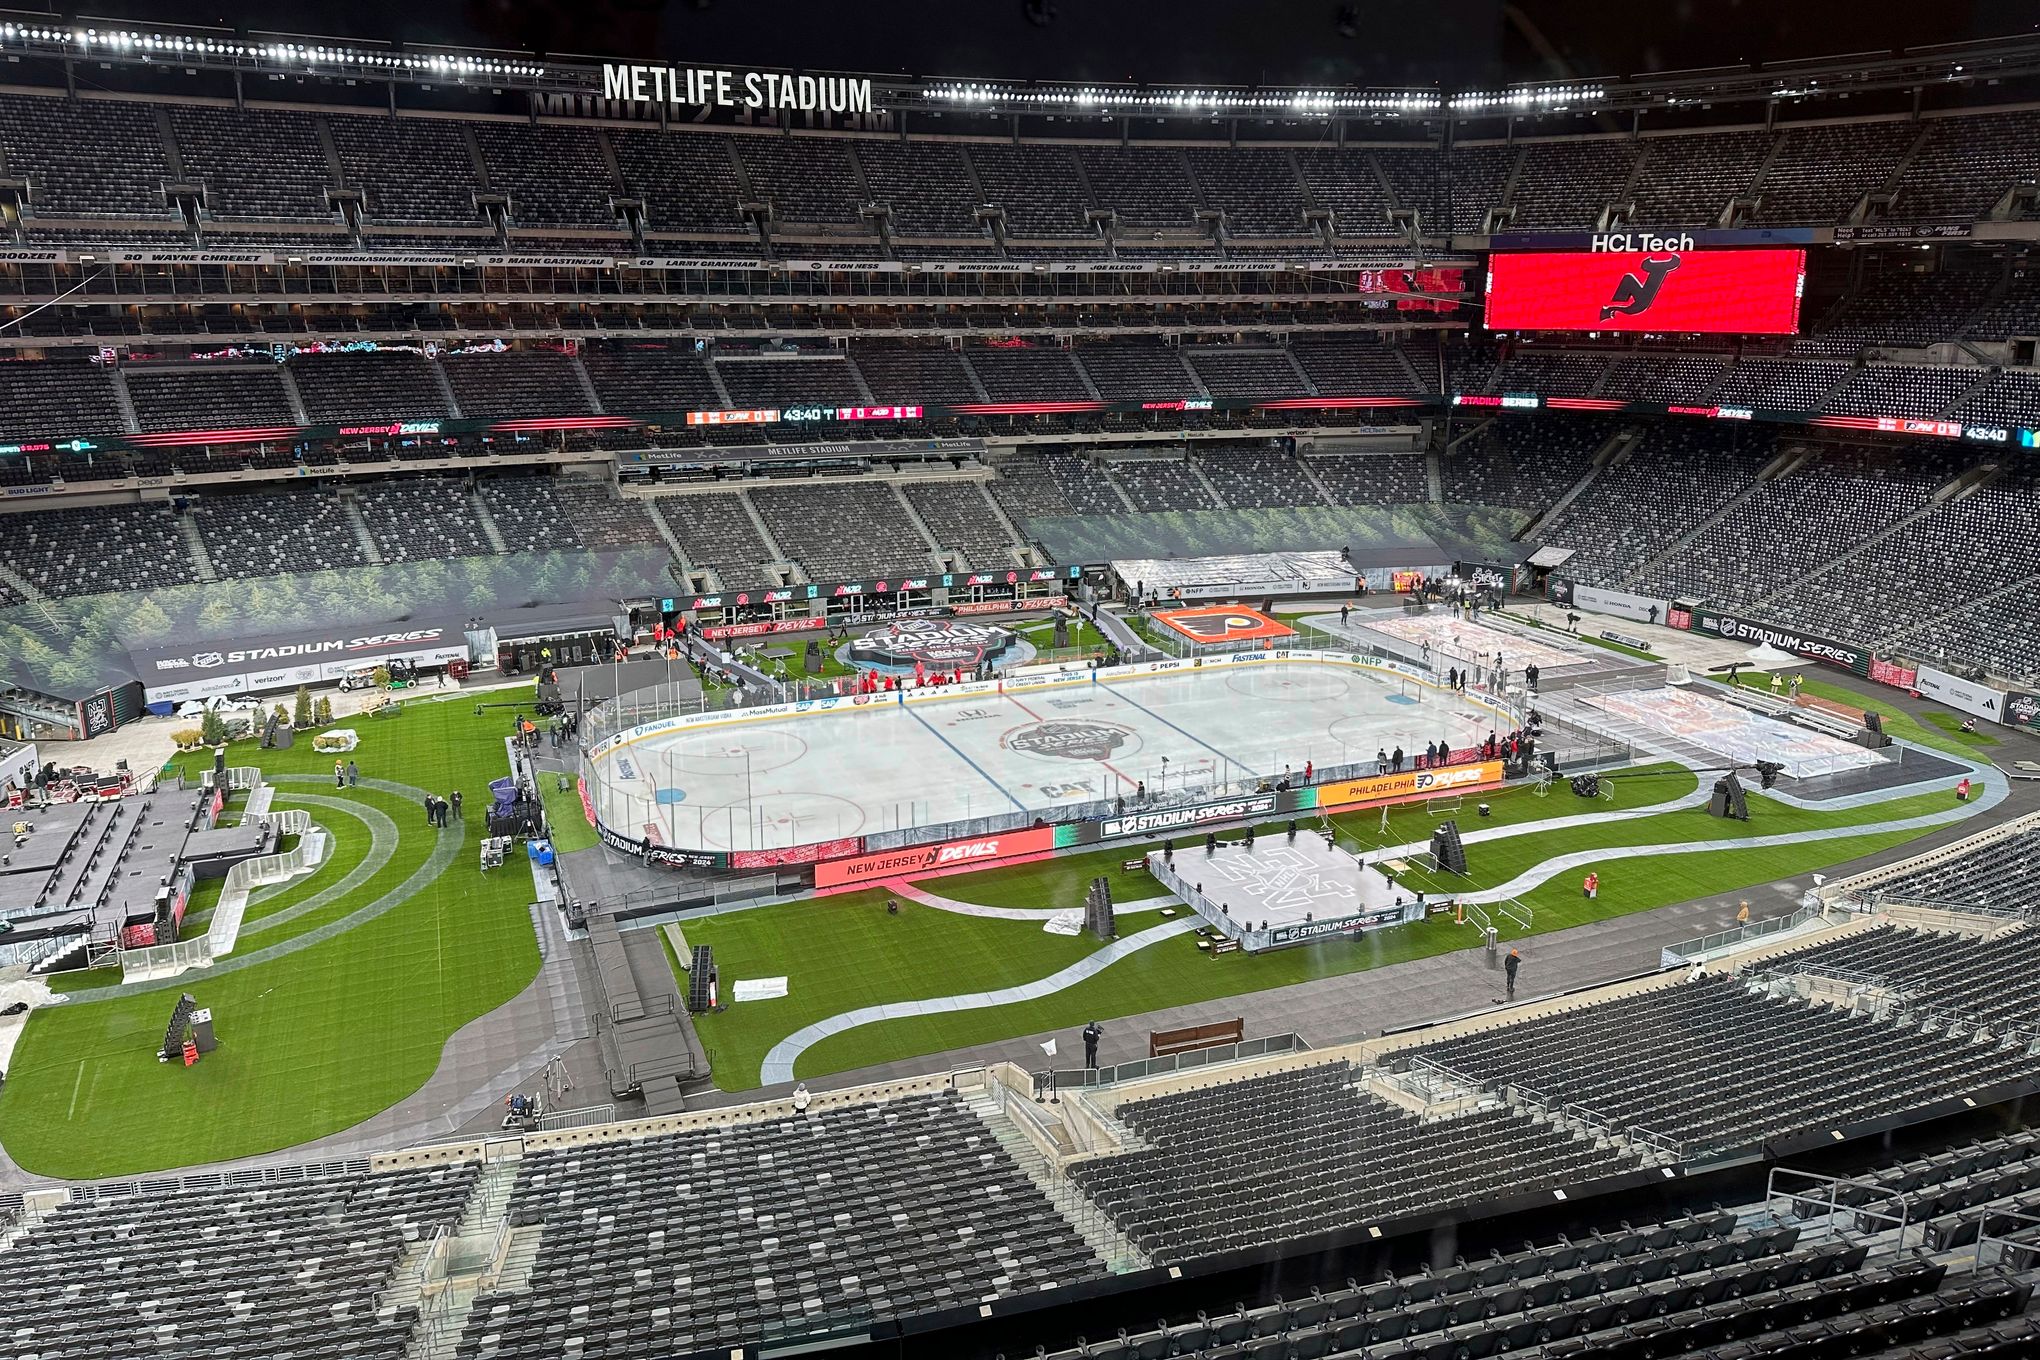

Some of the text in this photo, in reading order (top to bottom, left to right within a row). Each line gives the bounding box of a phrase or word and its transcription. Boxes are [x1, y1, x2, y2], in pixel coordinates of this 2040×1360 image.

[603, 64, 871, 113] METLIFE STADIUM
[1592, 233, 1694, 252] HCLTech
[784, 410, 821, 421] 43:40
[358, 426, 390, 434] JERSEY
[400, 423, 440, 434] DEVILS
[1966, 428, 2007, 442] 43:40
[940, 440, 971, 449] MetLife
[648, 453, 682, 461] MetLife
[768, 446, 850, 456] METLIFE STADIUM
[712, 625, 765, 637] NEW JERSEY
[777, 620, 816, 631] DEVILS
[853, 626, 1012, 650] STADIUM
[1737, 623, 1800, 650] STADIUM
[1799, 641, 1858, 664] SERIES
[228, 640, 343, 663] STADIUM
[345, 628, 443, 648] SERIES
[1232, 654, 1266, 663] FASTENAL
[1276, 650, 1289, 659] CAT
[1361, 656, 1382, 666] NFP
[254, 675, 283, 684] verizon
[796, 703, 811, 711] SAP
[821, 700, 836, 708] SAP
[749, 706, 788, 716] MassMutual
[644, 720, 676, 733] FANDUEL
[1013, 728, 1126, 749] STADIUM
[1040, 781, 1096, 798] CAT
[1349, 780, 1415, 796] PHILADELPHIA
[1138, 809, 1195, 830] STADIUM
[1195, 802, 1247, 820] SERIES
[940, 841, 998, 861] DEVILS
[847, 854, 924, 875] NEW JERSEY
[1275, 869, 1296, 887] NHL
[1300, 915, 1380, 936] STADIUM SERIES
